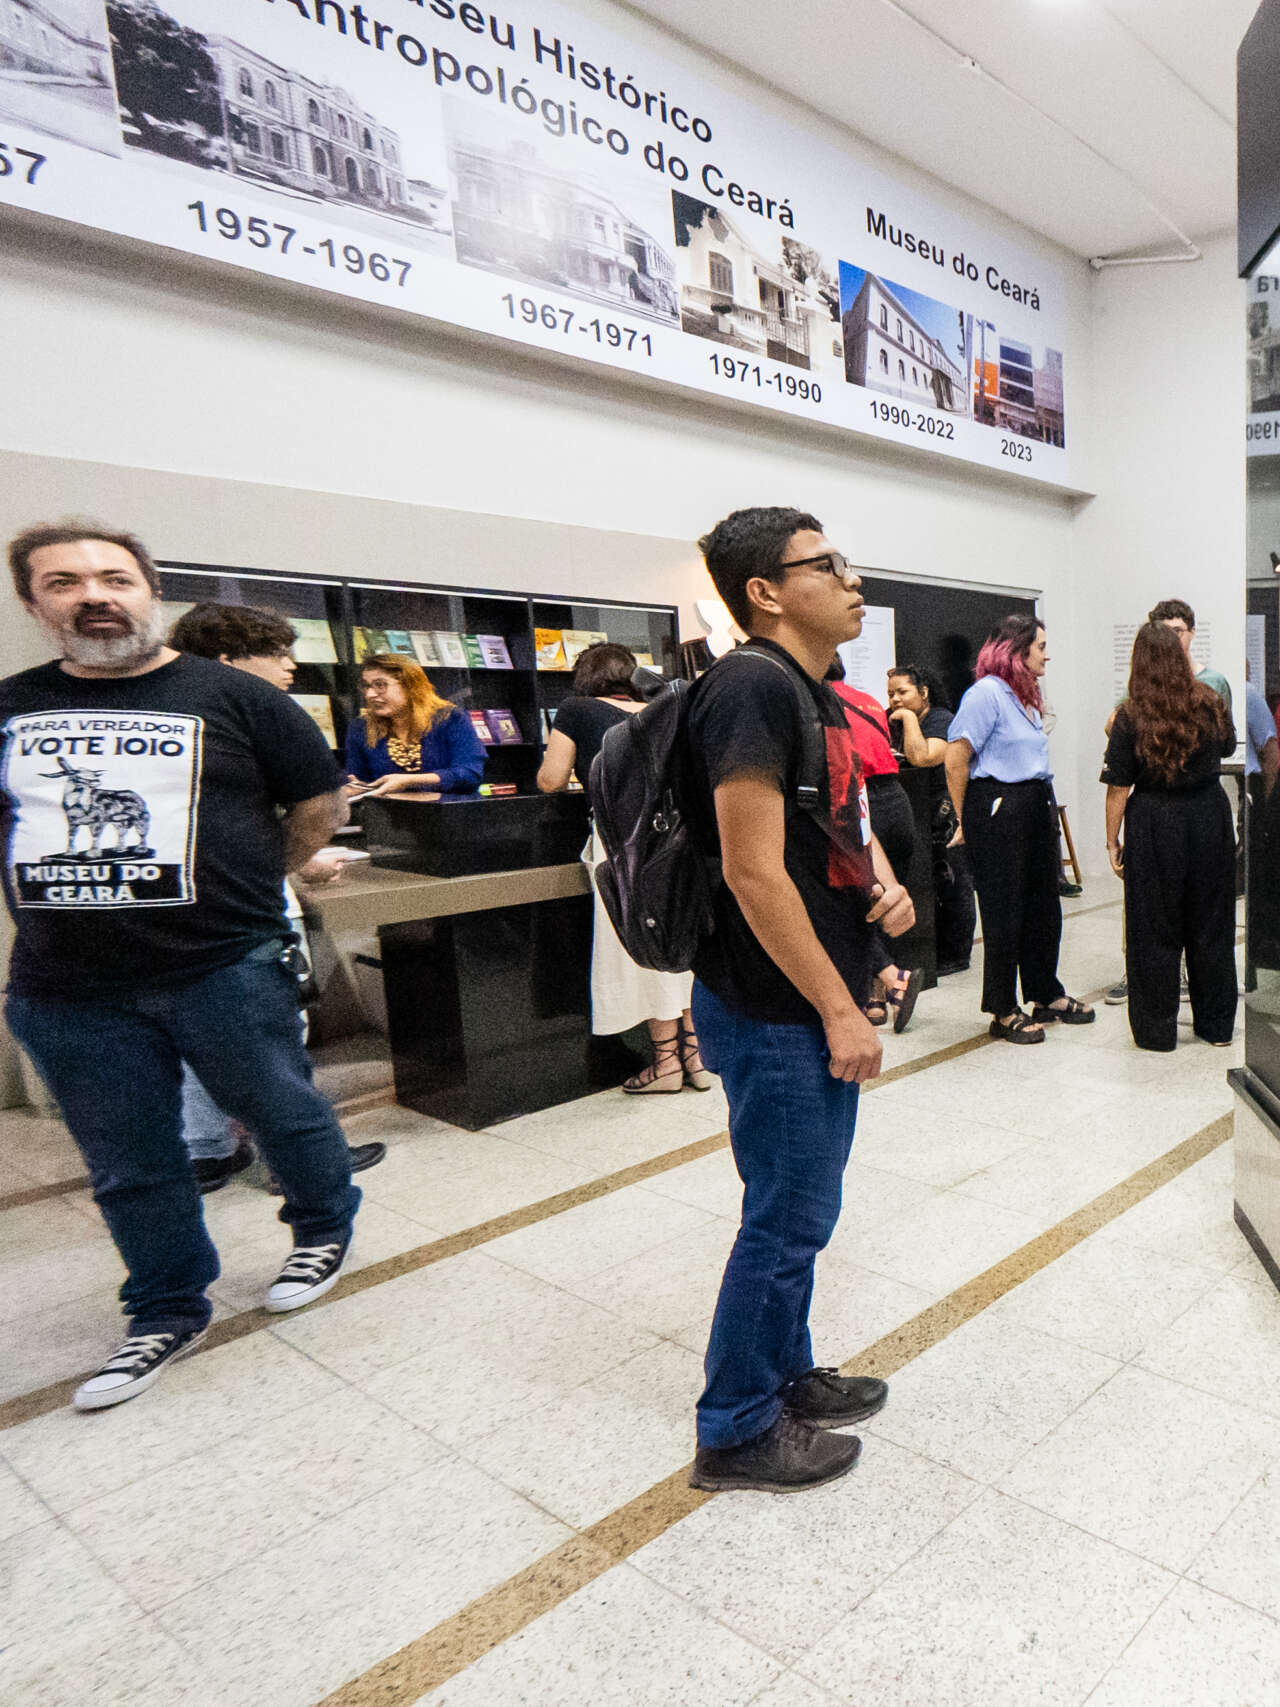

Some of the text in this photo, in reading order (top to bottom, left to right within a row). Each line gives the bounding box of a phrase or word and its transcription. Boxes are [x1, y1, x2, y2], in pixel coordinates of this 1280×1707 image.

[414, 0, 714, 143] seu Histórico
[643, 141, 689, 182] do
[701, 164, 796, 230] Ceará
[187, 199, 413, 288] 1957-1967
[865, 206, 1042, 312] Museu do Ceará
[501, 293, 654, 358] 1967-1971
[708, 353, 823, 405] 1971-1990
[869, 400, 956, 441] 1990-2022
[1000, 438, 1034, 464] 2023
[20, 719, 185, 736] PARA VEREADOR
[20, 736, 105, 757] VOTE
[25, 864, 161, 882] MUSEU DO
[46, 881, 136, 901] CEARÁ
